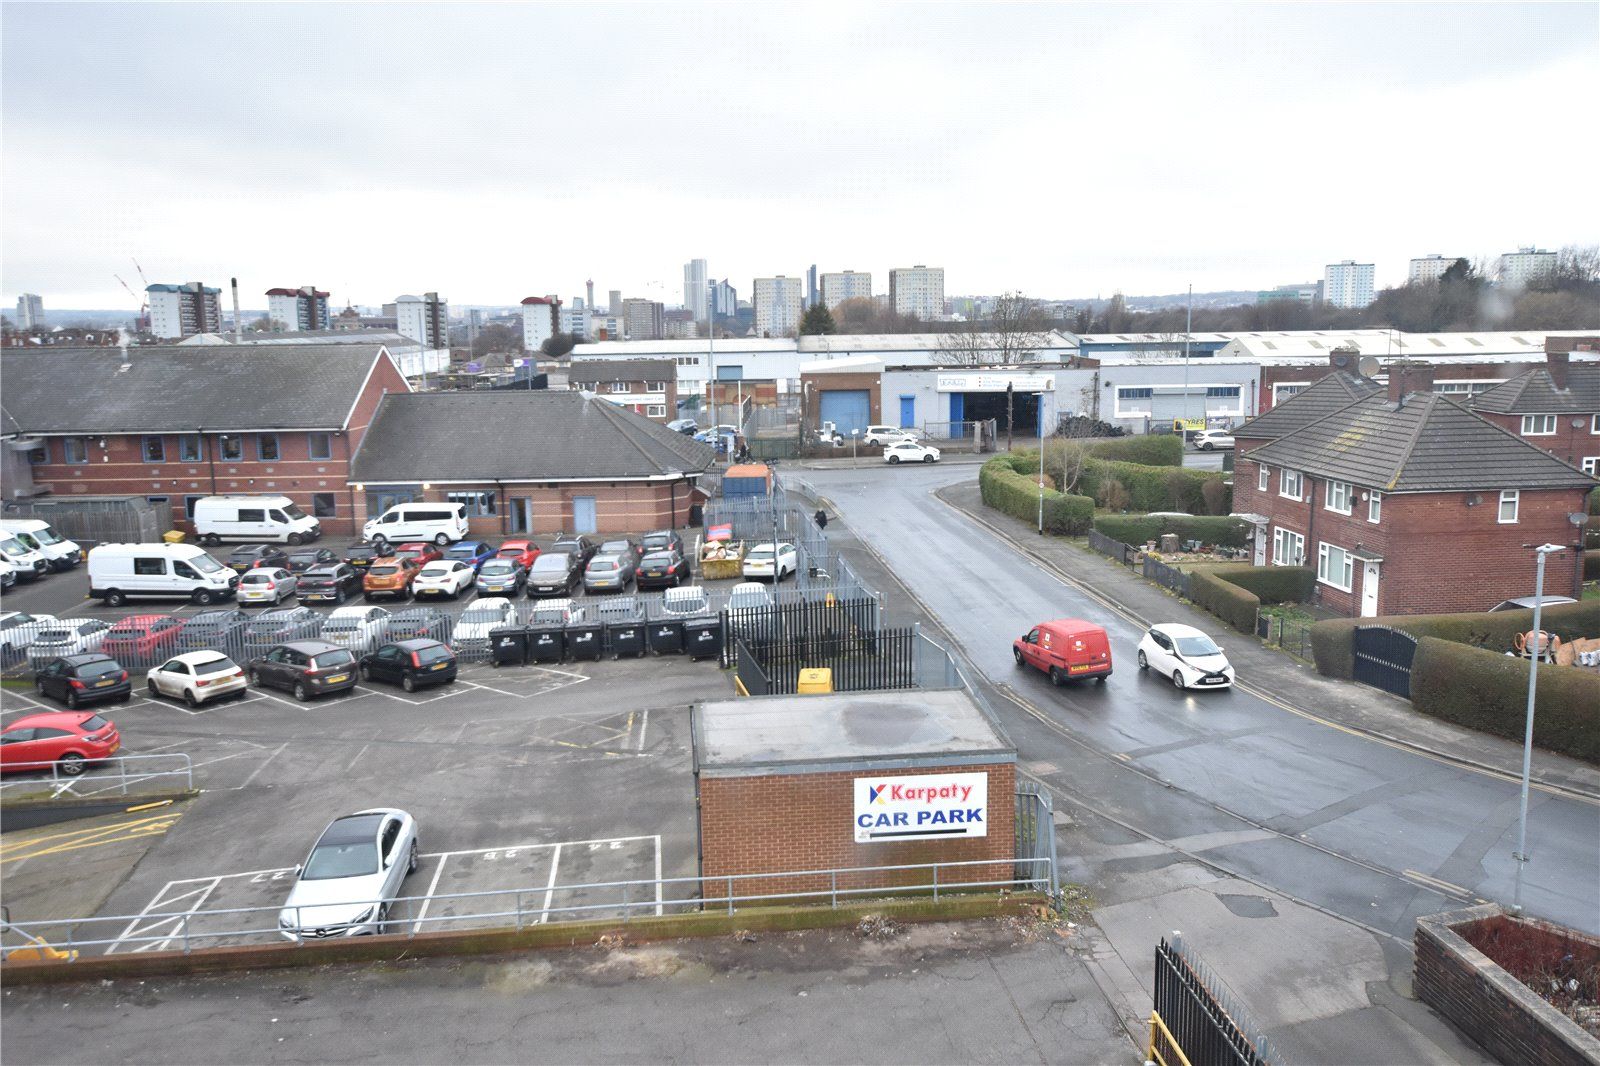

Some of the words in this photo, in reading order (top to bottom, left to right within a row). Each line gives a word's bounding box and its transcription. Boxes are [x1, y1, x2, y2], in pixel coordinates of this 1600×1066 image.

[891, 783, 973, 804] Karpaty
[857, 812, 909, 828] CAR
[917, 808, 984, 825] PARK
